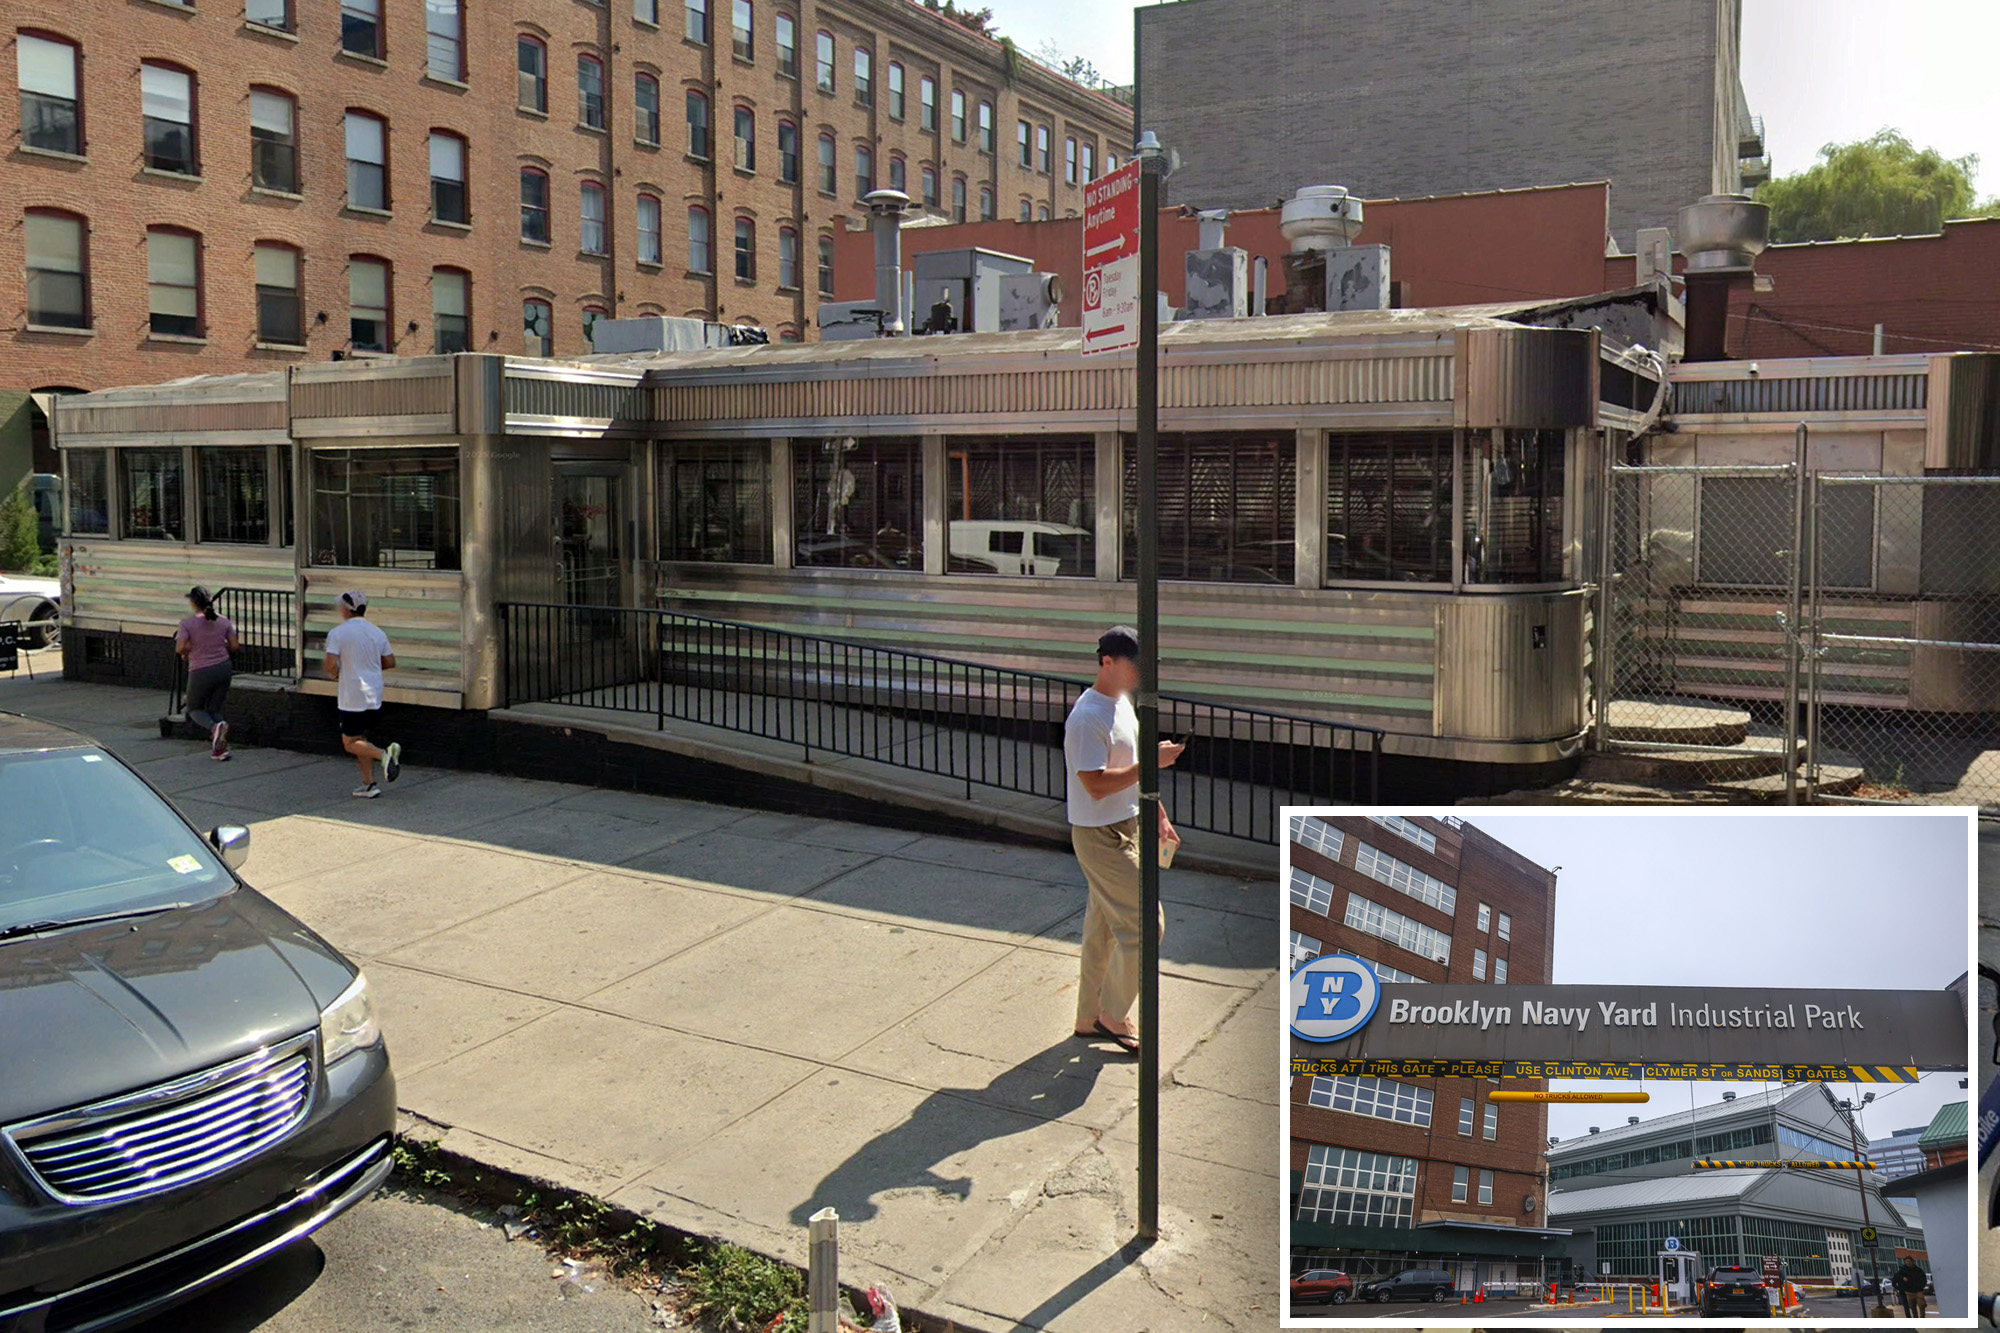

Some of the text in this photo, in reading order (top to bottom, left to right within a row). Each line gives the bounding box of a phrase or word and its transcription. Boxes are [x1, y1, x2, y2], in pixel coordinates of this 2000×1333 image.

[1087, 173, 1132, 208] NO STANDING
[1087, 206, 1115, 230] Anytime
[0, 635, 16, 645] .C.
[1389, 999, 1864, 1032] Brooklyn Navy Yard Industrial Park
[1340, 1064, 1357, 1073] AT
[1369, 1064, 1398, 1074] THIS
[1402, 1064, 1436, 1074] GATE
[1451, 1065, 1500, 1075] PLEASE
[1516, 1066, 1541, 1076] USE
[1545, 1066, 1601, 1077] CLINTON
[1605, 1066, 1633, 1079] AVE,
[1646, 1067, 1697, 1078] CLYMER
[1701, 1068, 1717, 1078] ST
[1721, 1070, 1733, 1078] OR
[1736, 1068, 1780, 1079] SANDS
[1787, 1069, 1802, 1079] ST
[1806, 1069, 1847, 1080] GATES
[1978, 1109, 1999, 1151] bike
